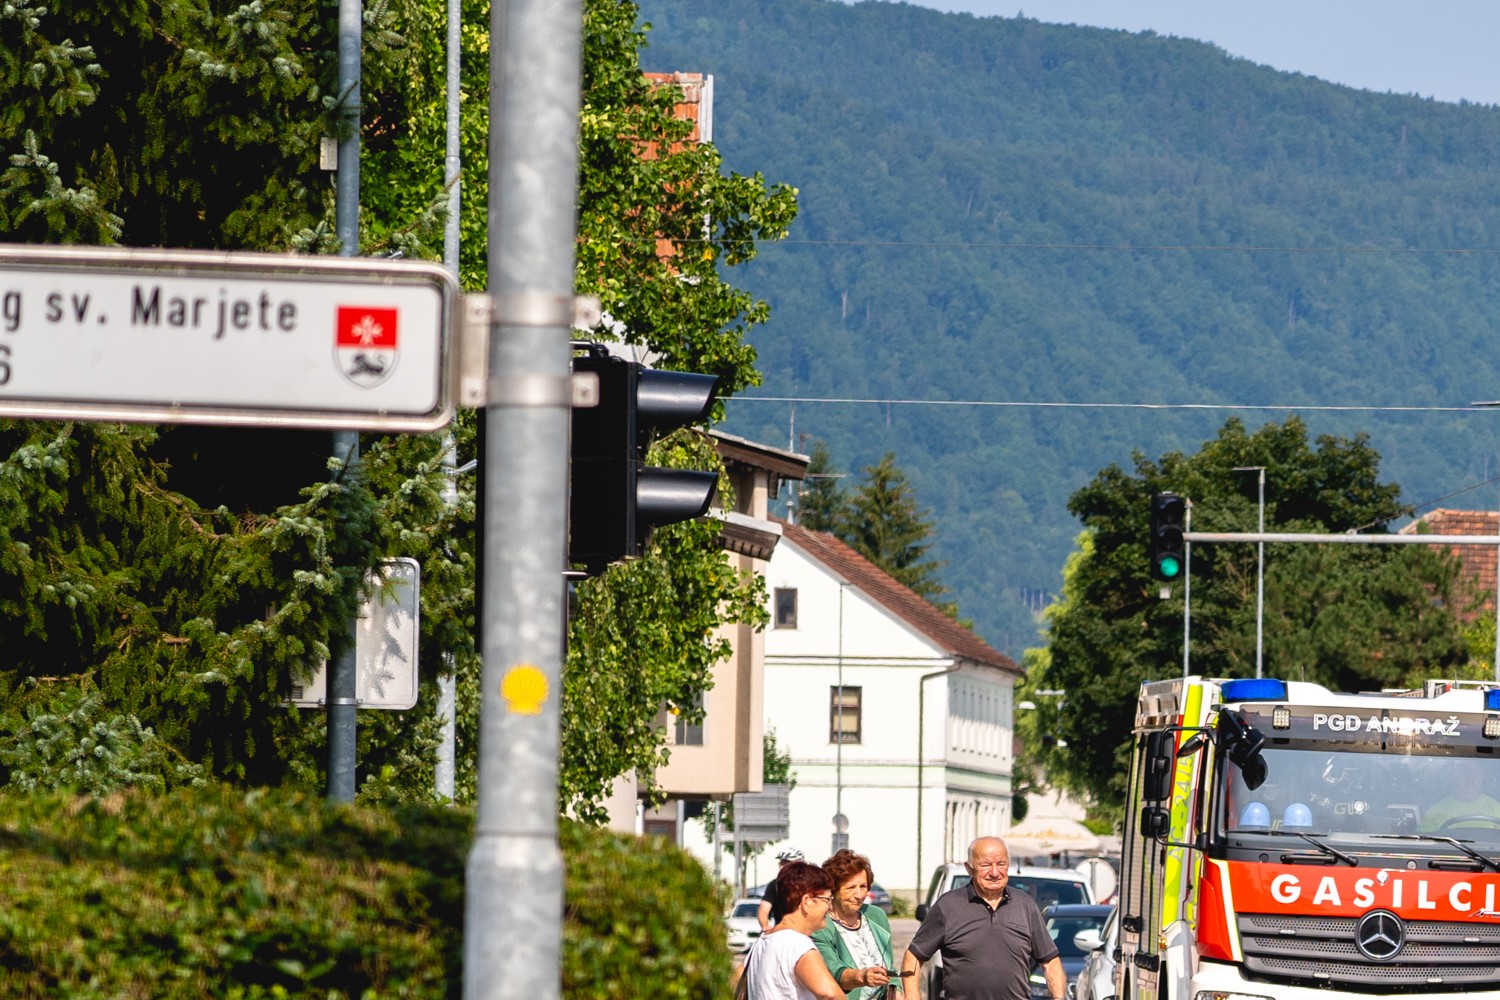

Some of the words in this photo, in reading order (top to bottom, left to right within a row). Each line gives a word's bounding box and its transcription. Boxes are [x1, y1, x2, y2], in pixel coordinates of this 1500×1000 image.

[44, 290, 108, 326] sv.
[130, 284, 299, 340] Marjete
[1312, 713, 1362, 732] PGD
[1365, 715, 1461, 737] ANDRAŽ
[1270, 873, 1496, 912] GASILCI
